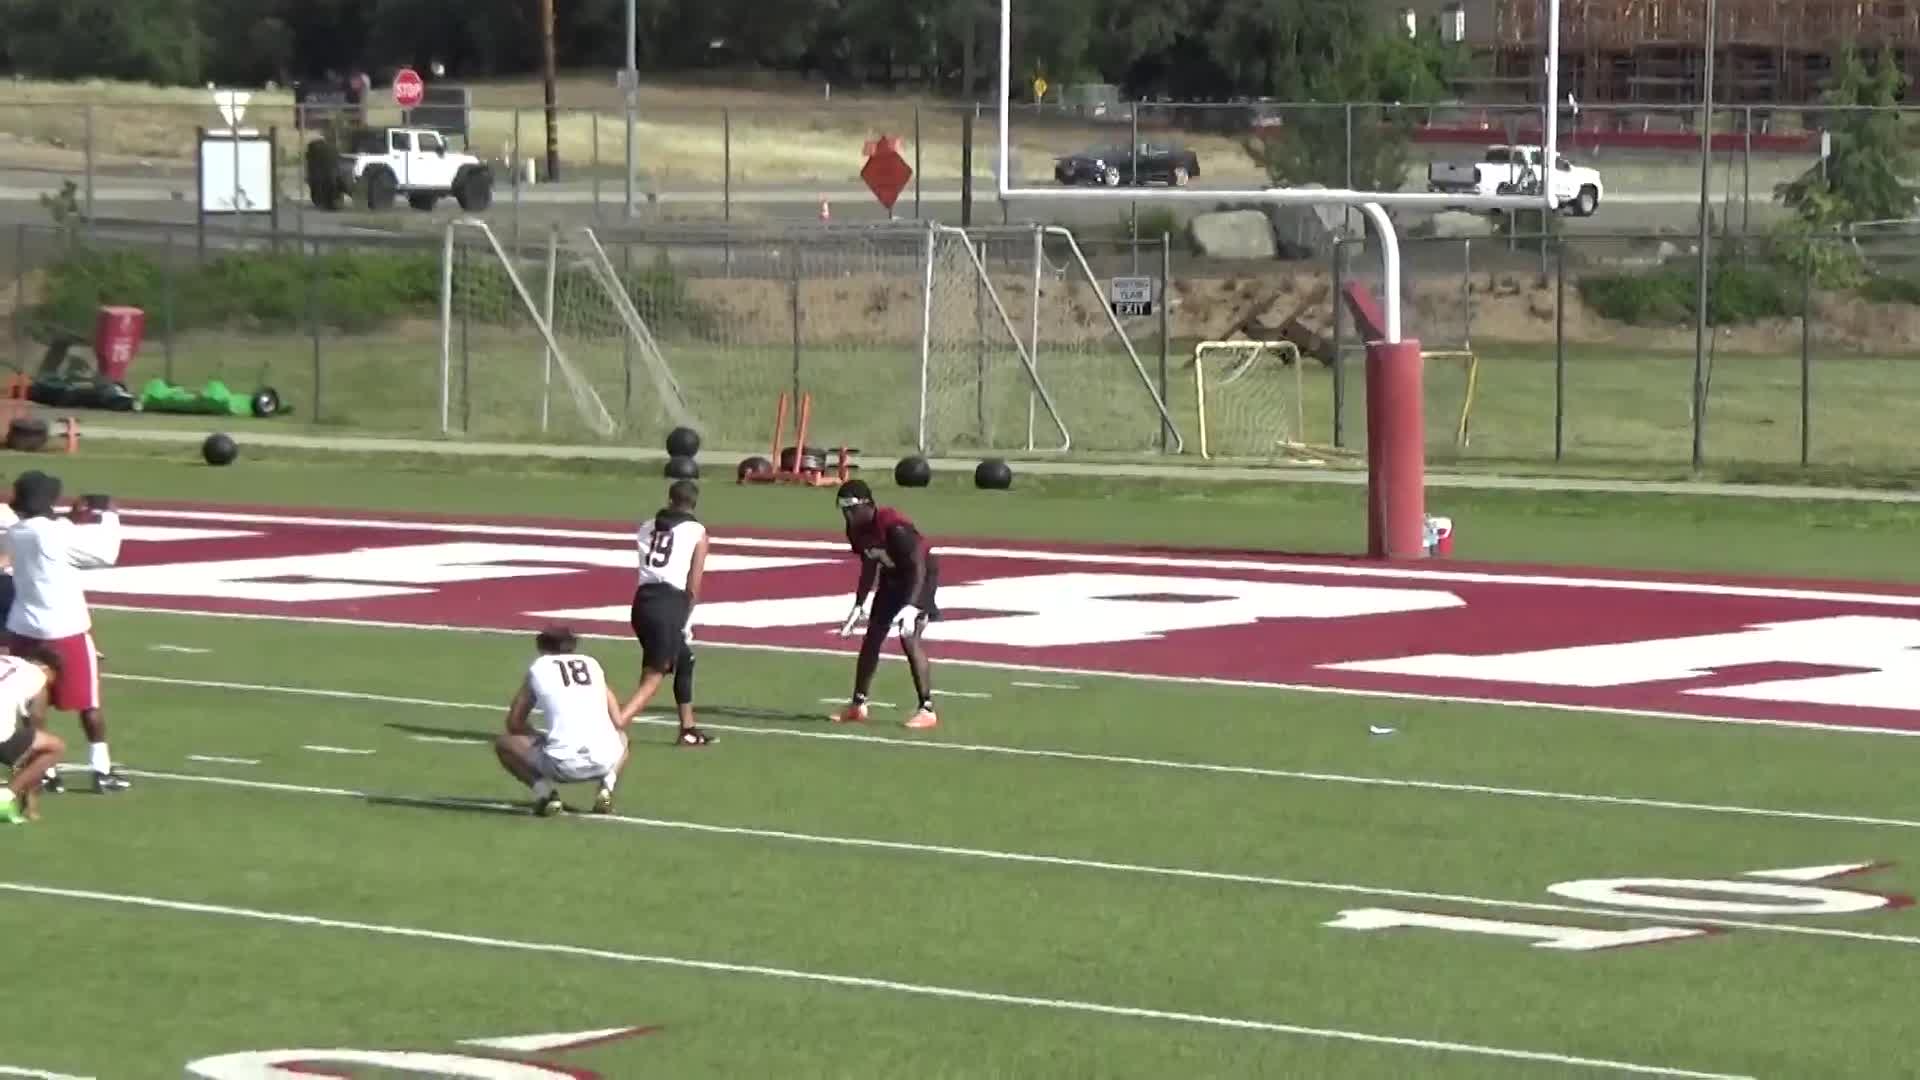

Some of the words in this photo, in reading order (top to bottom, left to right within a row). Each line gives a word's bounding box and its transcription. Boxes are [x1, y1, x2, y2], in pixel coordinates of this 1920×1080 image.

[396, 82, 421, 98] STOP
[1115, 302, 1145, 316] EXIT
[645, 529, 674, 568] 19
[552, 659, 592, 687] 18
[1320, 877, 1895, 950] 10
